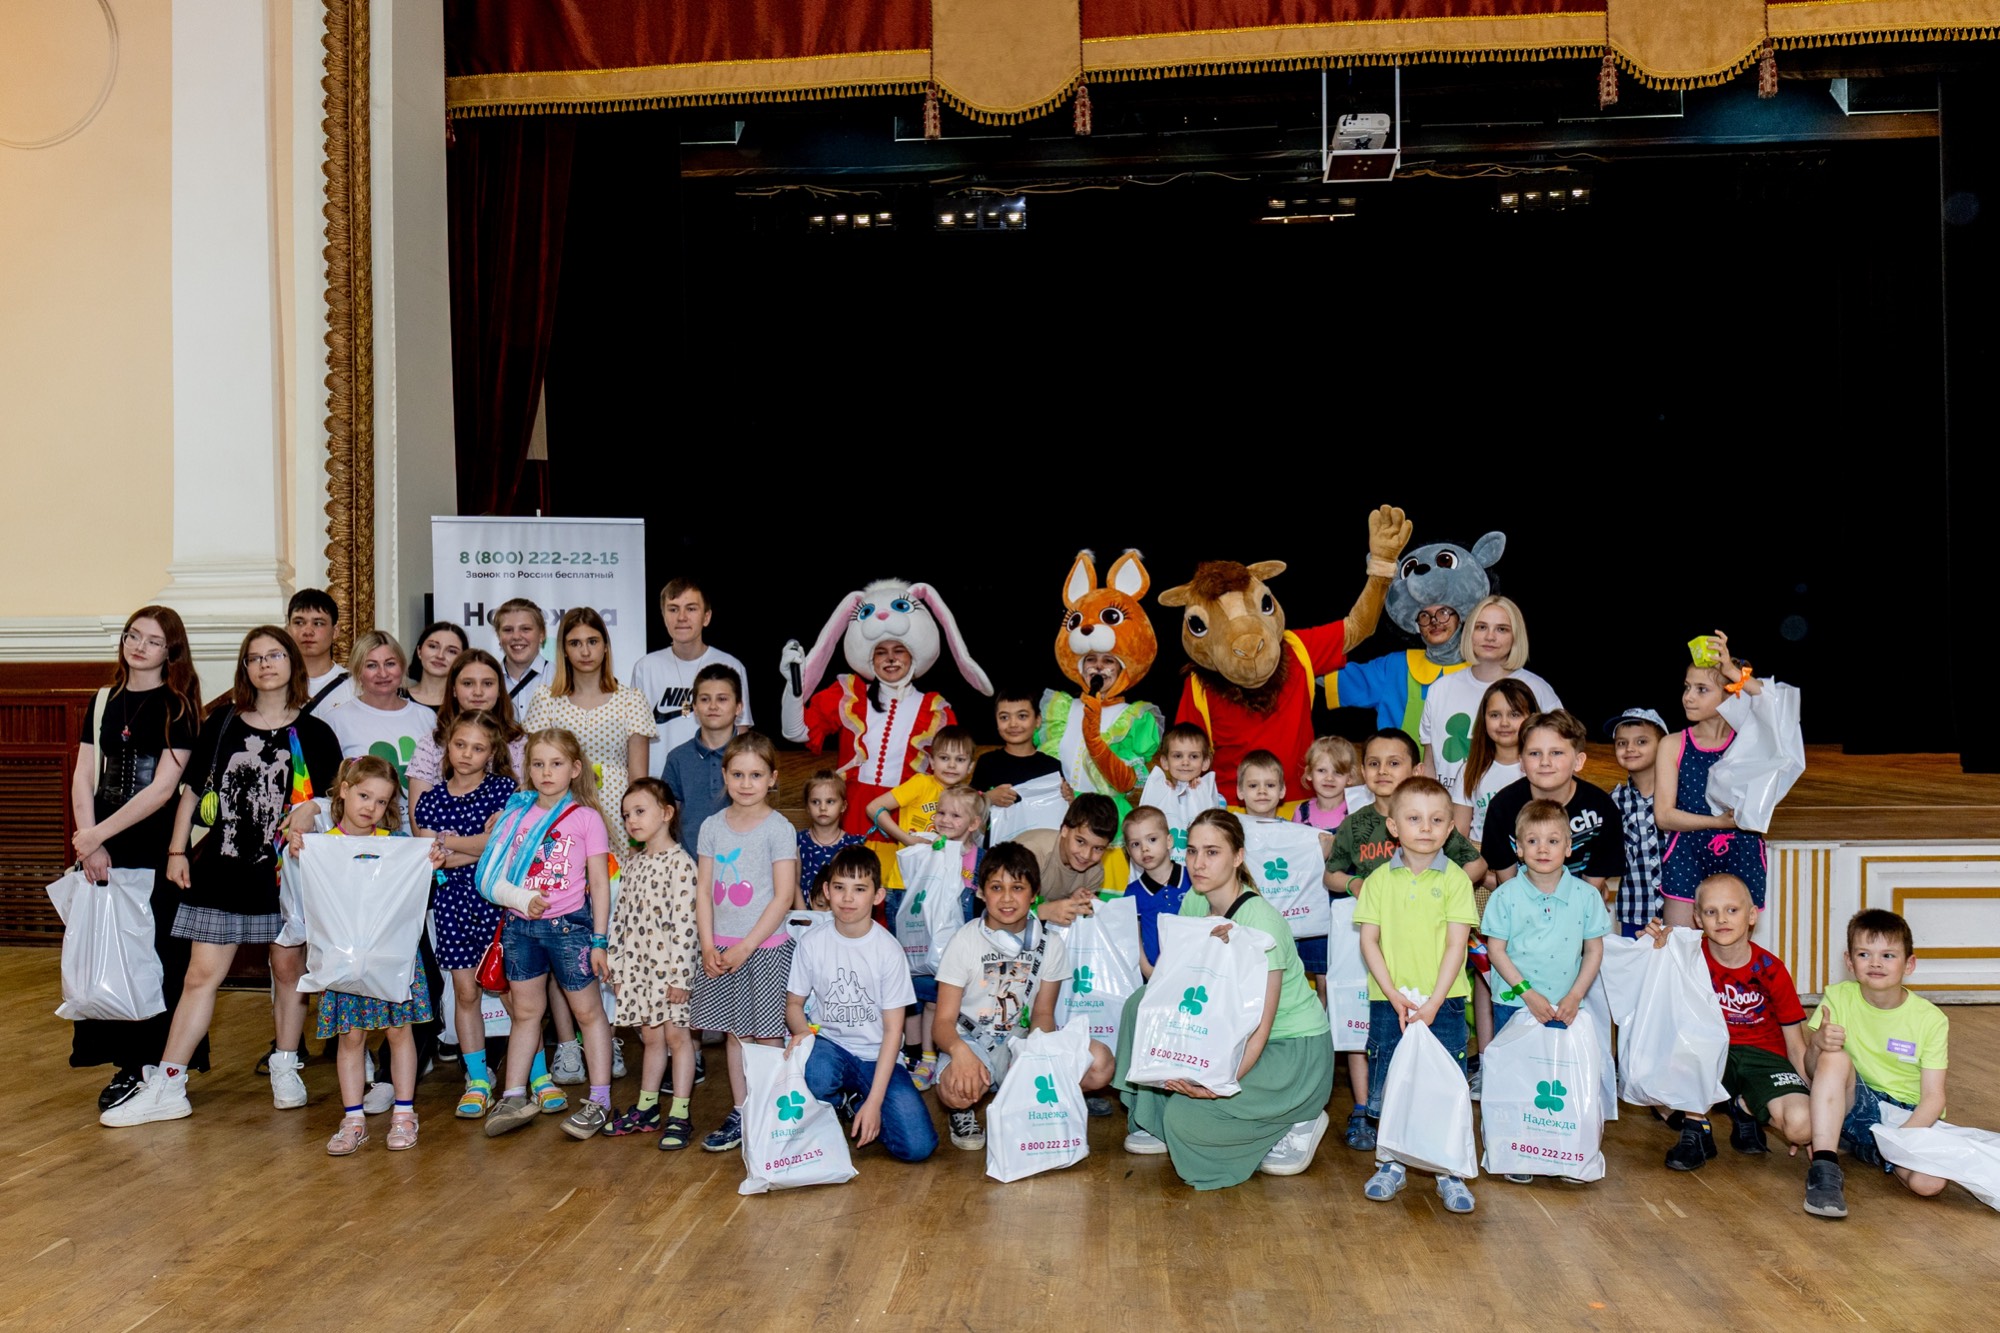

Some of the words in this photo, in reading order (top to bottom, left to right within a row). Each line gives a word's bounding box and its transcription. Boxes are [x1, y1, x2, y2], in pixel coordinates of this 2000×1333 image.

[459, 551, 470, 565] 8
[475, 550, 524, 566] (800)
[528, 551, 619, 566] 222-22-15
[465, 570, 500, 579] Звонок
[517, 570, 553, 579] России
[555, 570, 614, 579] бесплатный
[822, 1001, 878, 1028] Kappa
[1094, 1025, 1104, 1034] 22
[1105, 1025, 1114, 1034] 15
[1347, 1019, 1353, 1028] 8
[1150, 1047, 1156, 1056] 8
[1186, 1054, 1198, 1065] 22
[1200, 1058, 1210, 1068] 15
[1523, 1113, 1576, 1130] Надежда
[1020, 1142, 1026, 1151] 8
[1027, 1141, 1045, 1150] 800
[1046, 1140, 1060, 1149] 222
[1072, 1138, 1081, 1147] 15
[1511, 1142, 1517, 1151] 8
[1519, 1144, 1539, 1155] 800
[1541, 1147, 1559, 1159] 222
[1560, 1151, 1572, 1161] 22
[1575, 1153, 1584, 1162] 15
[765, 1161, 772, 1171] 8
[773, 1156, 791, 1169] 800
[803, 1151, 814, 1160] 22
[814, 1148, 824, 1157] 15
